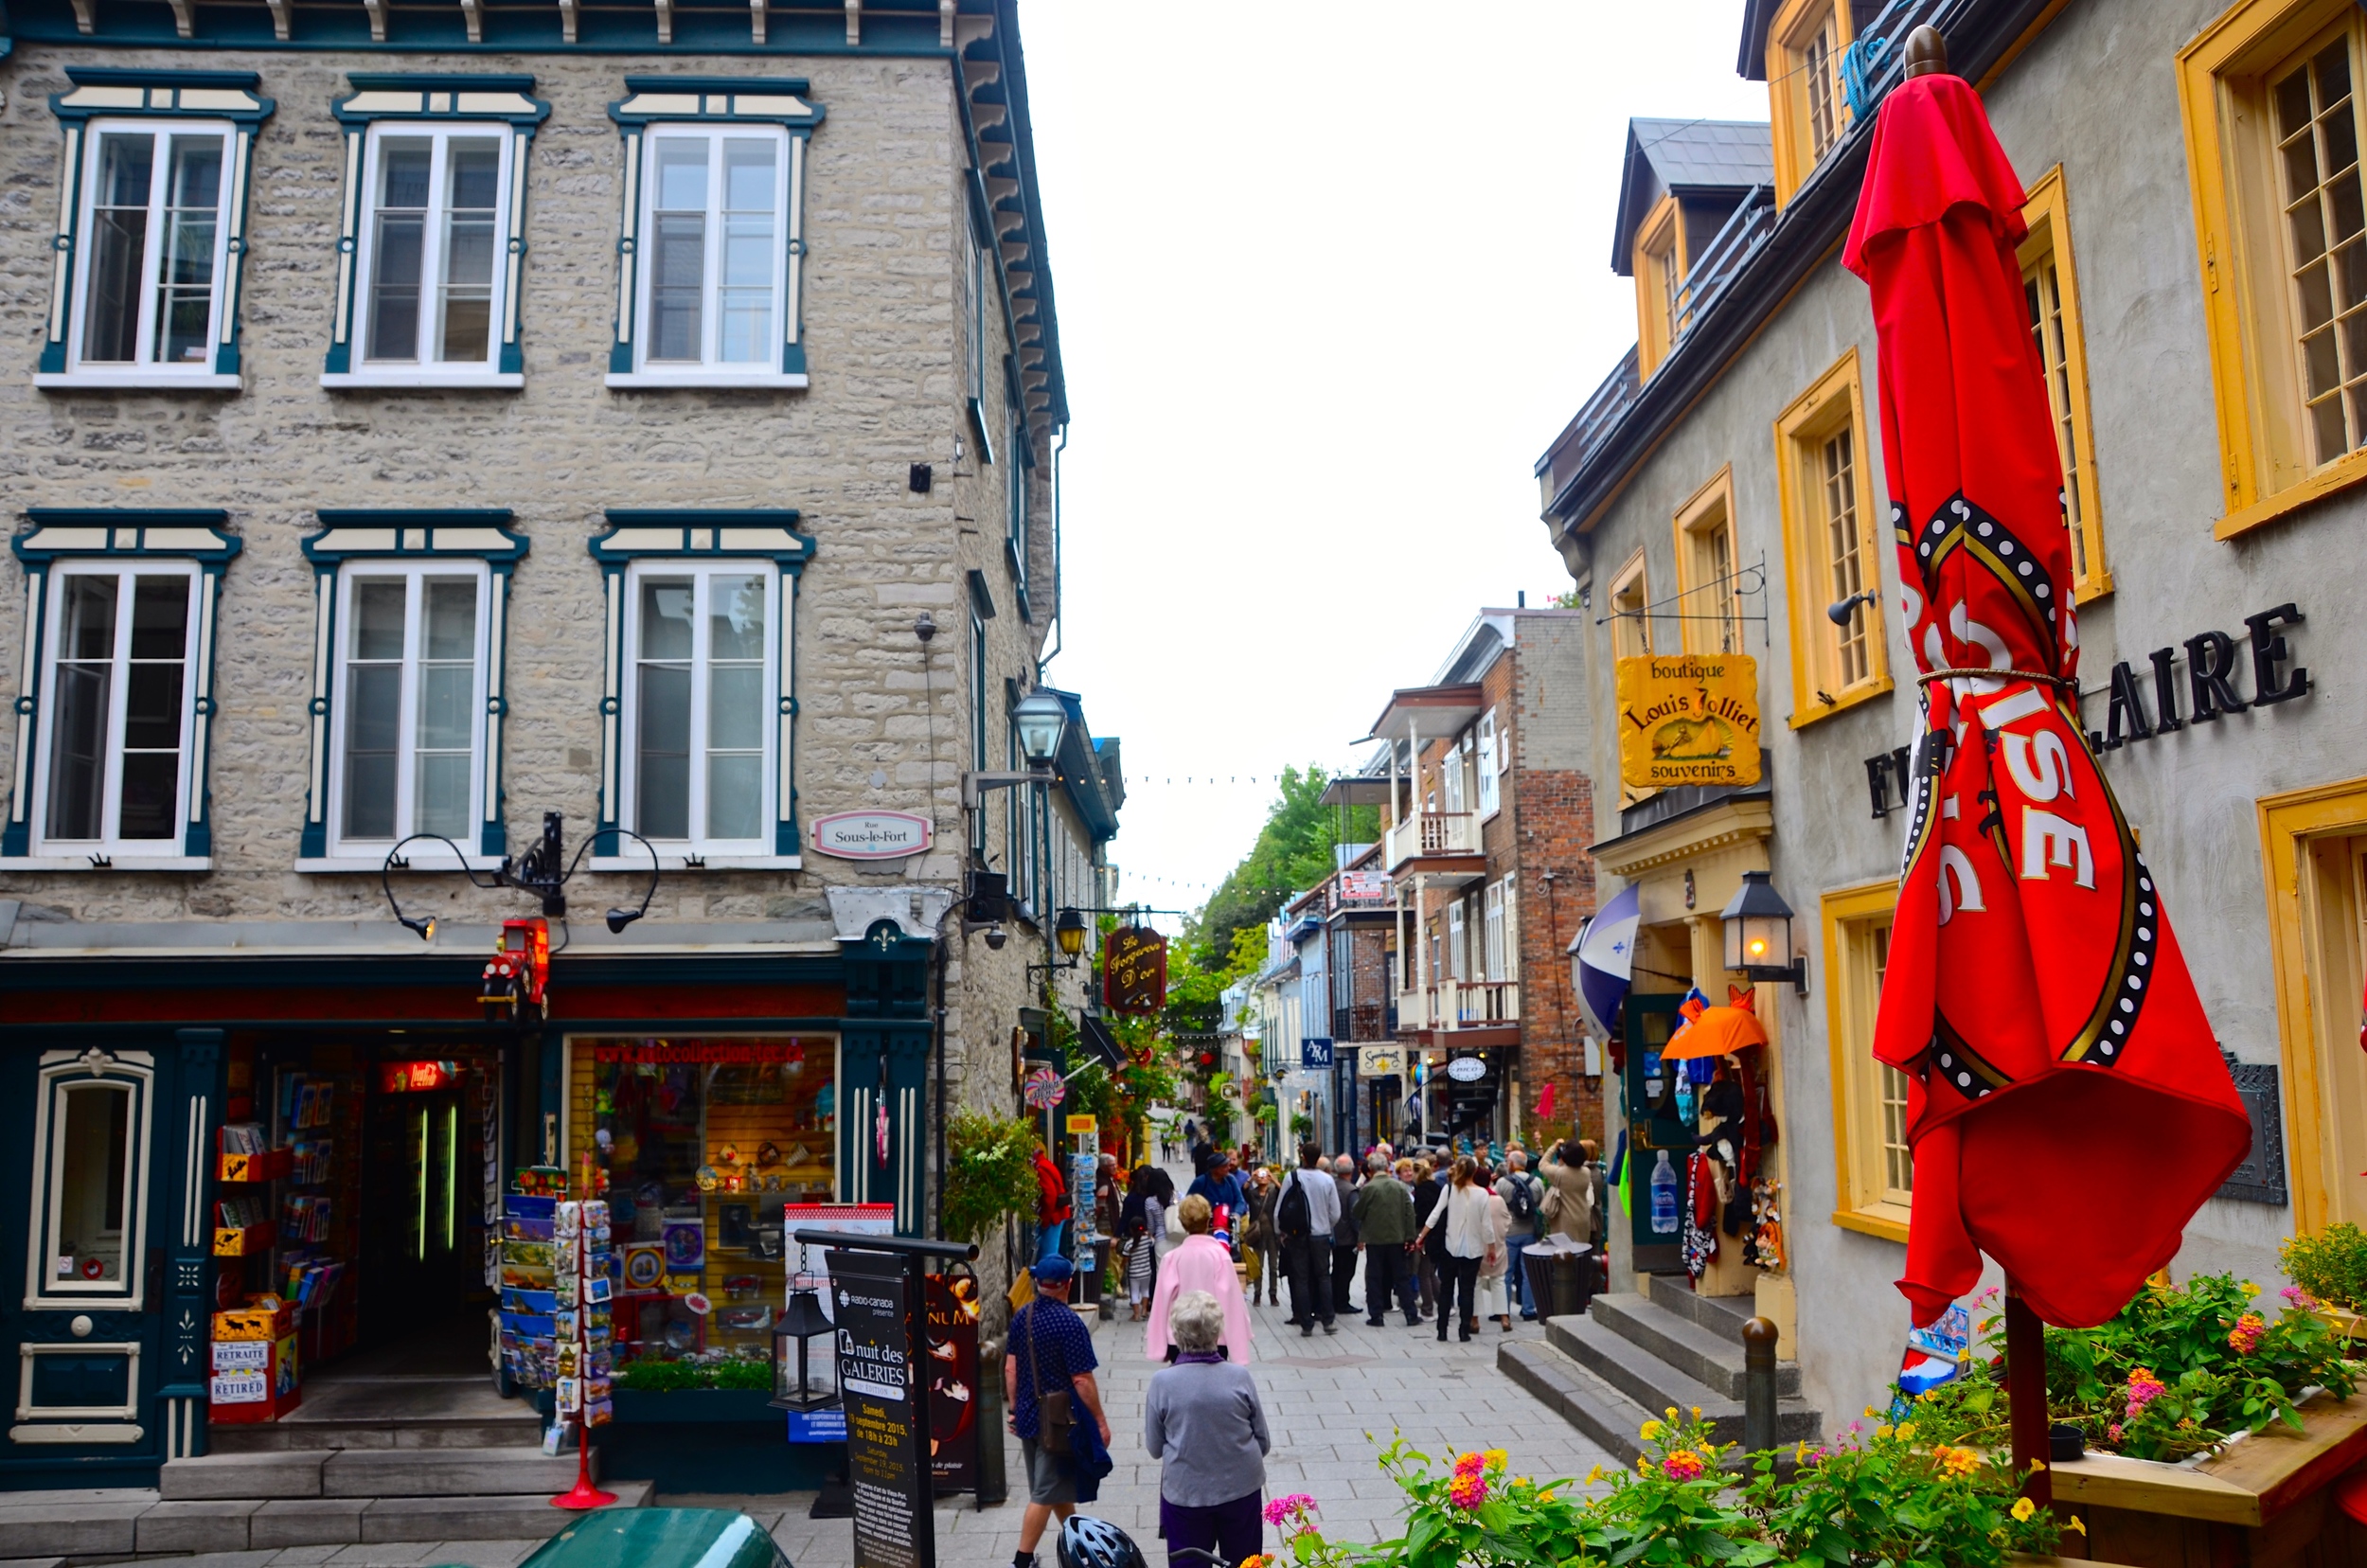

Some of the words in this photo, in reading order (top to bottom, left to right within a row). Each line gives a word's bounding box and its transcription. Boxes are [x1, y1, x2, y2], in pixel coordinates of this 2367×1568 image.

[1651, 658, 1725, 683] boutique
[1625, 694, 1689, 734] Louis
[1693, 687, 1758, 733] Jolliet
[1651, 761, 1735, 779] souvenirs
[835, 831, 907, 843] Sous-le-Fort
[1123, 935, 1138, 951] Le
[1110, 943, 1161, 974] Forgeron
[814, 1279, 831, 1288] HISTO
[856, 1345, 879, 1360] nuit
[881, 1345, 903, 1363] des
[841, 1359, 904, 1385] GALERIES
[215, 1382, 262, 1395] RETIRED
[865, 1384, 888, 1396] ÉDITION
[863, 1403, 886, 1419] Samedi,
[856, 1417, 885, 1431] septembre
[887, 1422, 907, 1436] 2015,
[856, 1429, 863, 1438] de
